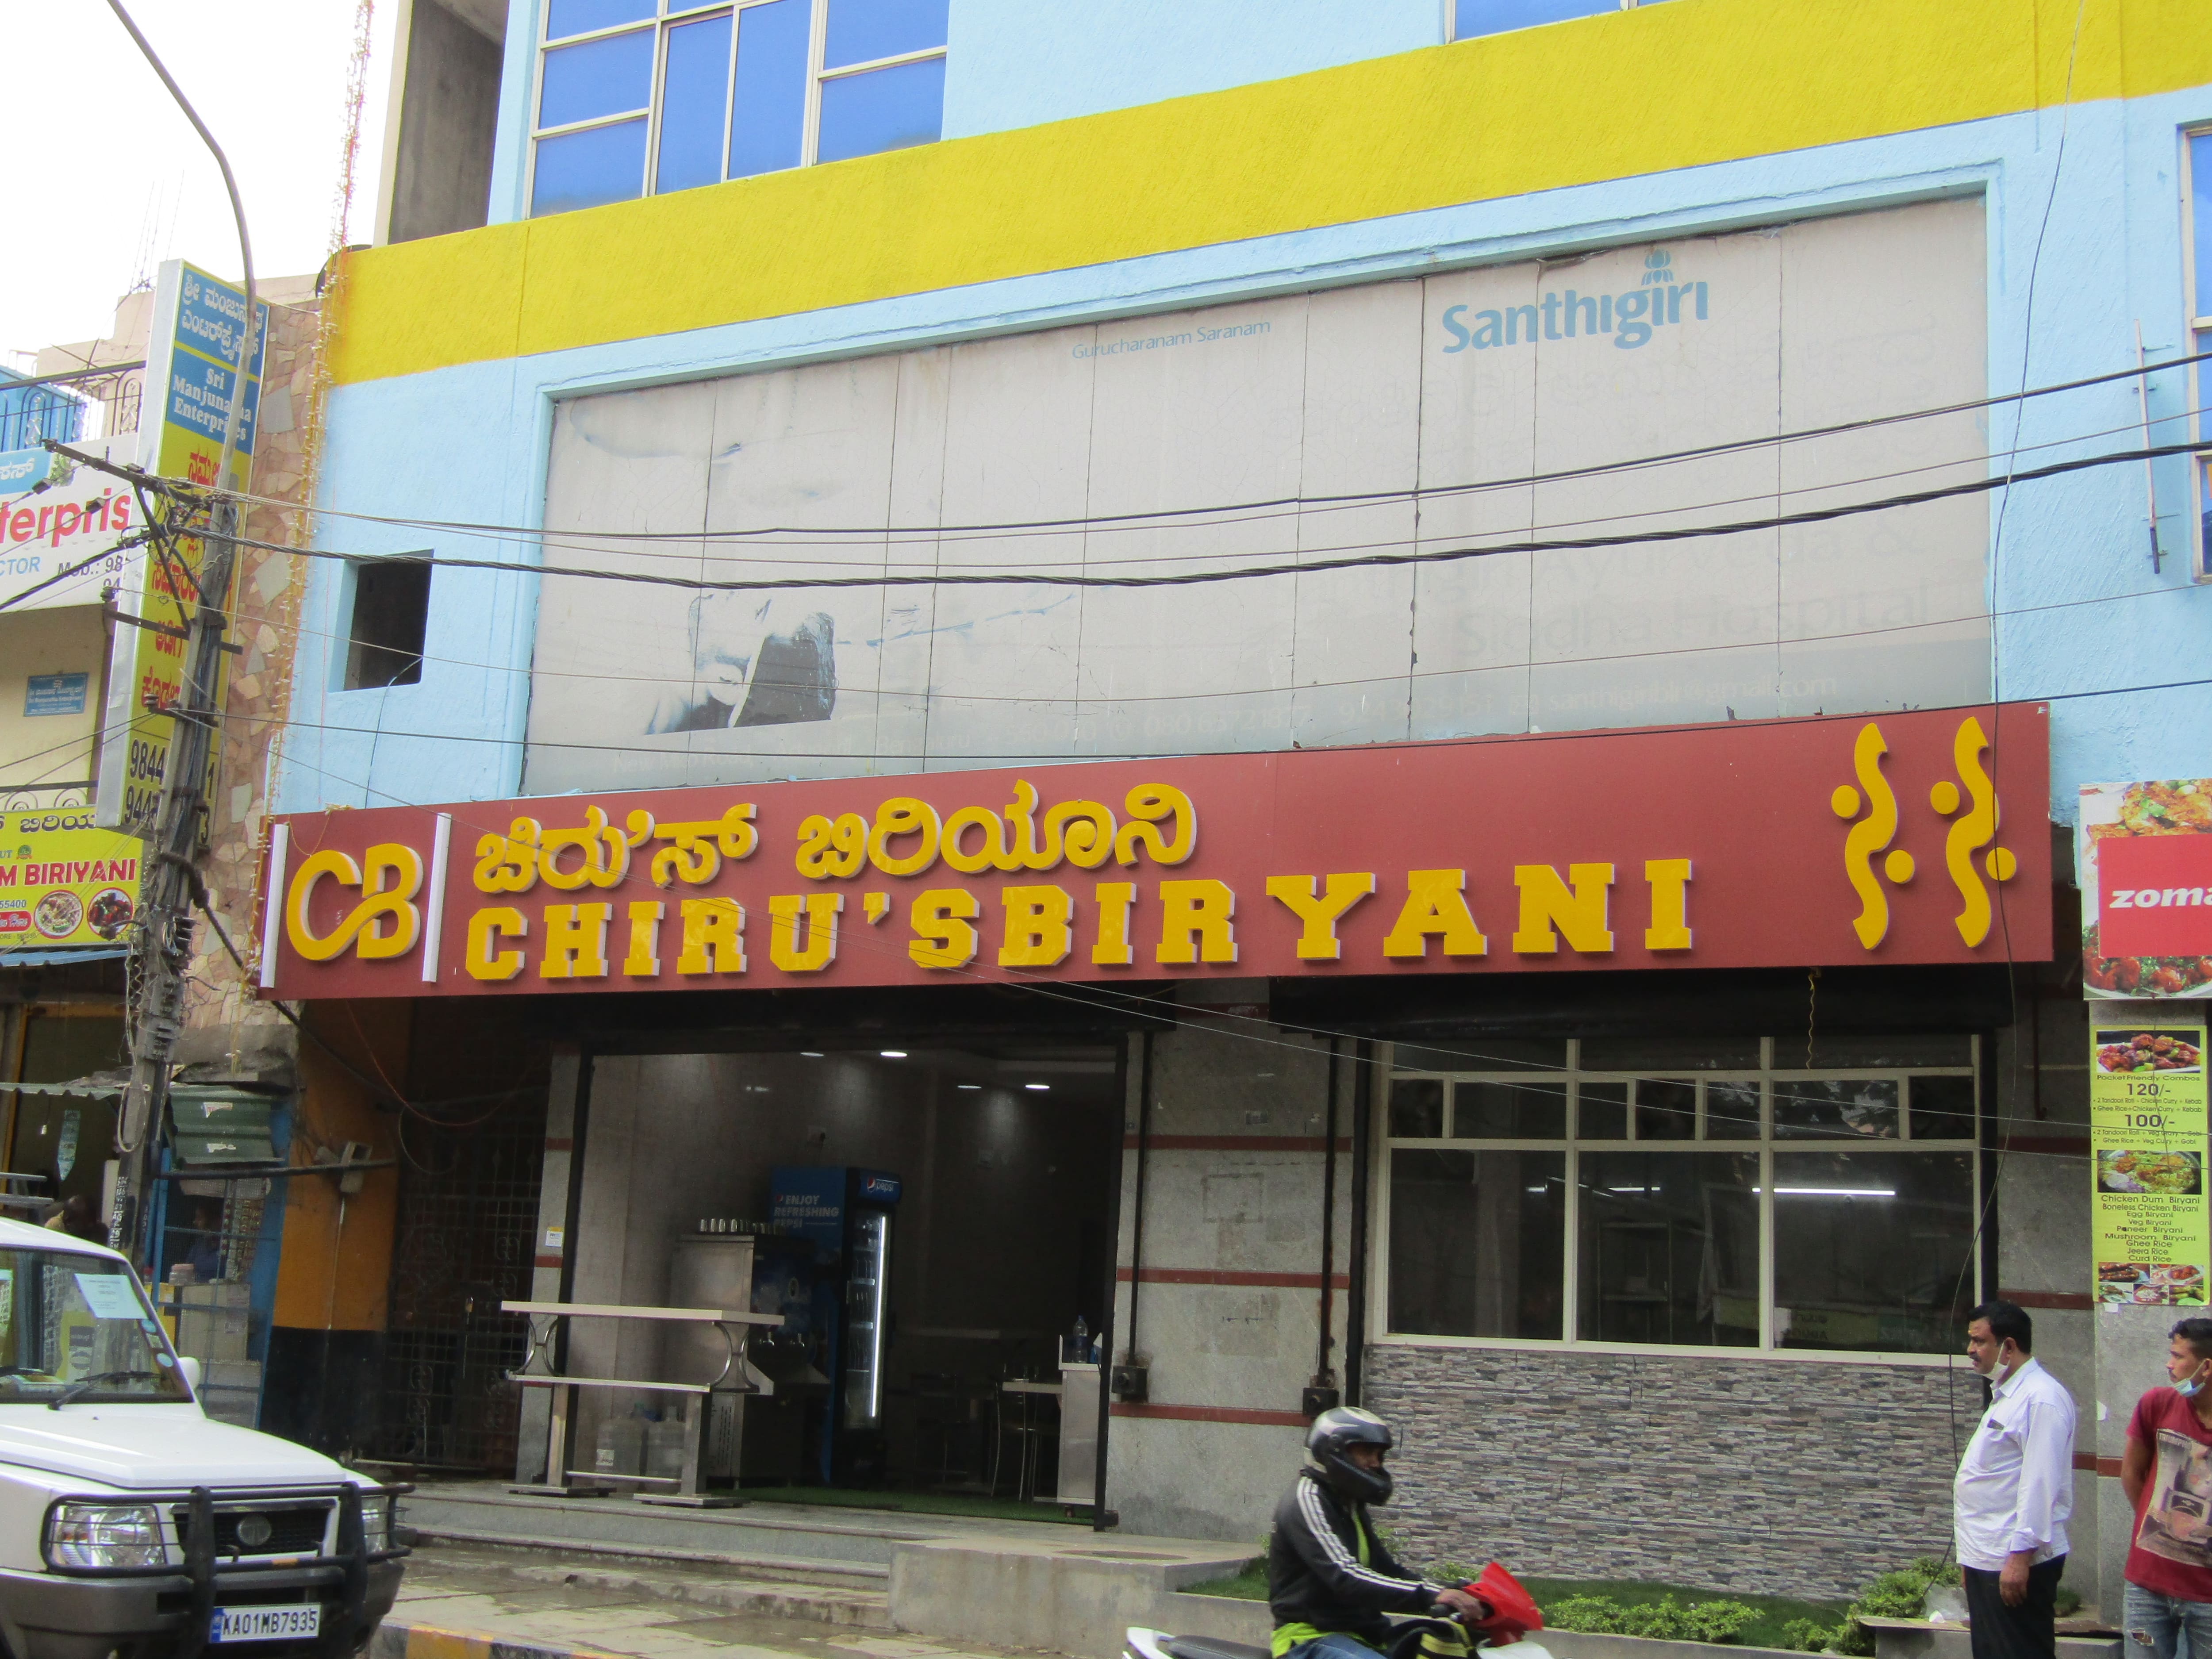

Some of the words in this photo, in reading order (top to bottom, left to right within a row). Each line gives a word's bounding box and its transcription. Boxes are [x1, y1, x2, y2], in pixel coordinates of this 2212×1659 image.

[183, 274, 200, 305] ಶ್ರೀ
[1442, 281, 1708, 353] Santhigiri
[1072, 332, 1192, 359] Gurucharanam
[1197, 321, 1271, 343] Saranam
[206, 368, 225, 390] Sri
[25, 858, 136, 886] BIRIYANI
[997, 858, 1693, 968] BIRYANI
[2127, 1083, 2171, 1097] 120/-
[2125, 1114, 2175, 1128] 100/-
[876, 1182, 895, 1192] pepsi
[786, 1194, 820, 1205] ENJOY
[2169, 1196, 2200, 1204] Biryani
[774, 1206, 839, 1217] REFRESHING
[223, 1610, 318, 1635] KA01MB7935
